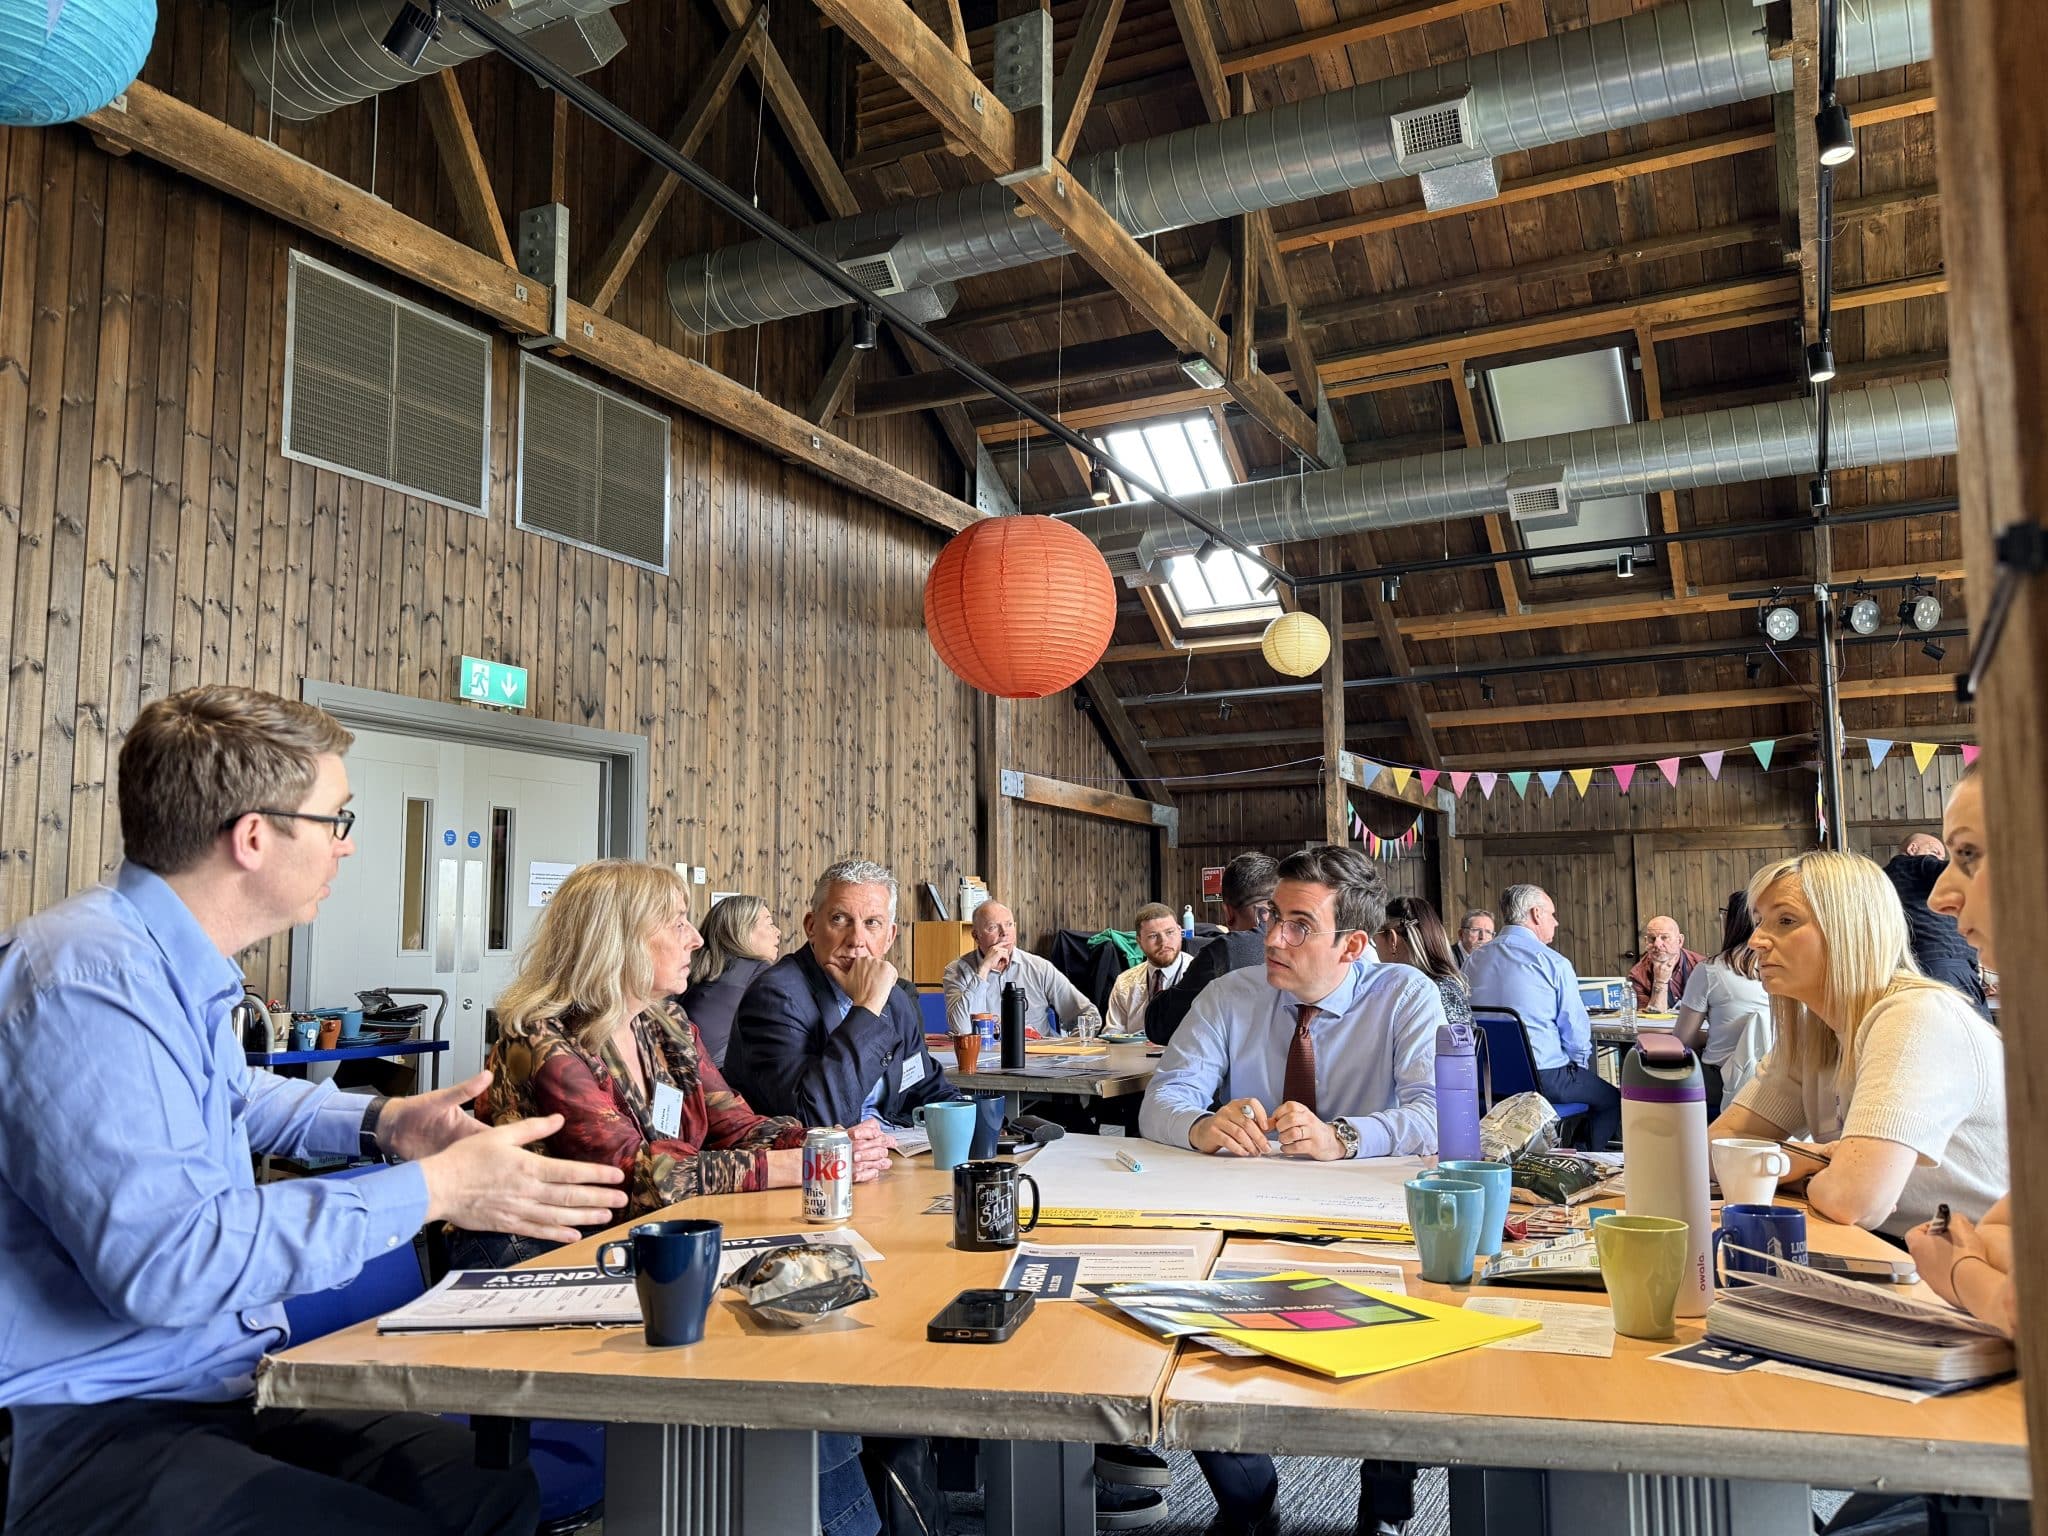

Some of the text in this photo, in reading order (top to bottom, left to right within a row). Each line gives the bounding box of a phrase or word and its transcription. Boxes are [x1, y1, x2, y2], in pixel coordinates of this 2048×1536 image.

[803, 1153, 847, 1181] oke
[805, 1187, 824, 1198] This
[980, 1193, 1012, 1226] SALT
